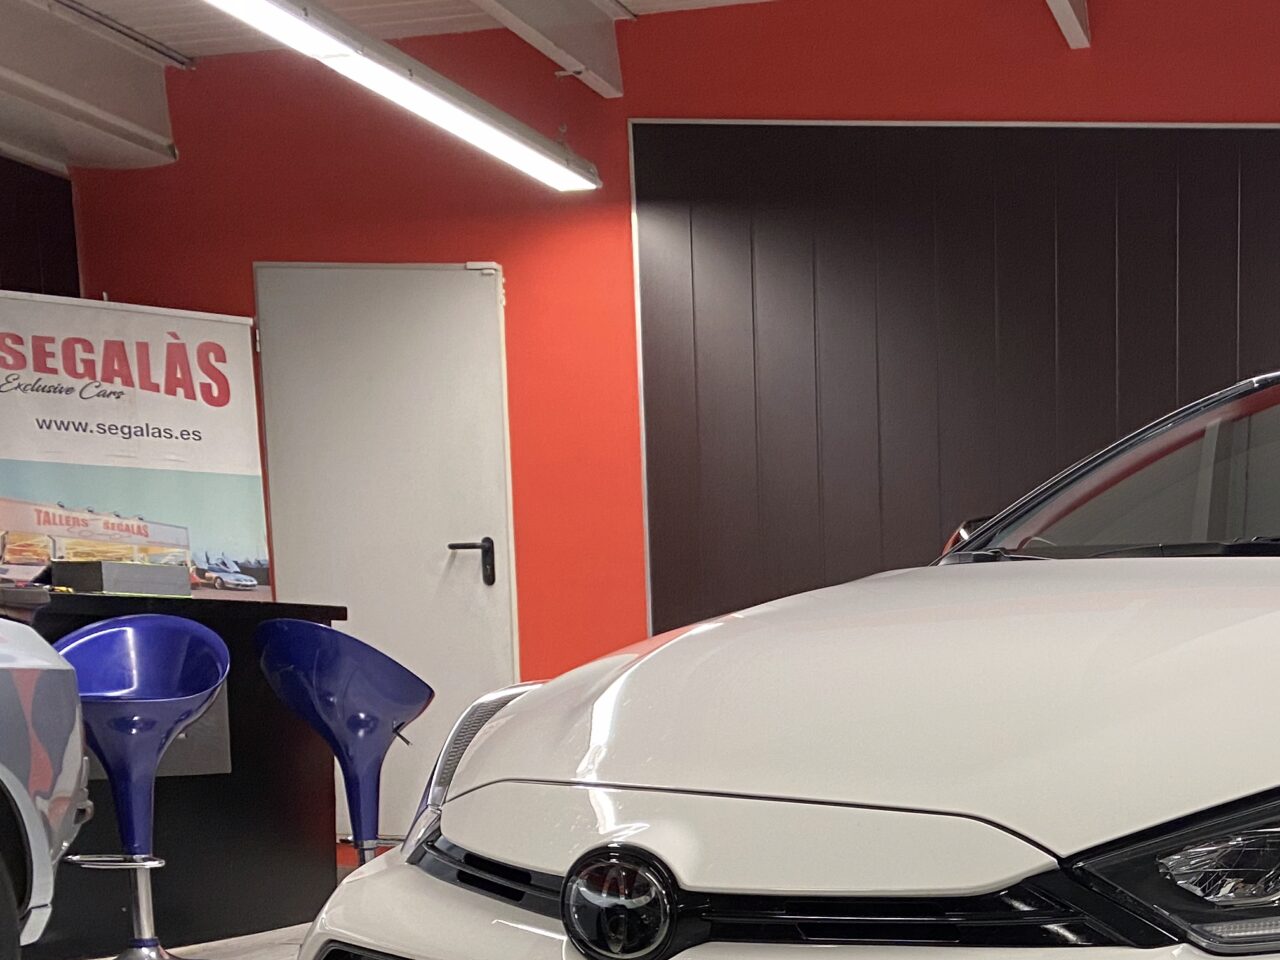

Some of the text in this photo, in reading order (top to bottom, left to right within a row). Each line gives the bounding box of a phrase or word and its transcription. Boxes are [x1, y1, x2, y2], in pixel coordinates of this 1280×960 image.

[0, 331, 231, 407] SEGALÀS
[0, 373, 125, 400] Exclusive Cars
[35, 417, 203, 442] www.segalas.es
[34, 508, 89, 528] TALLERS
